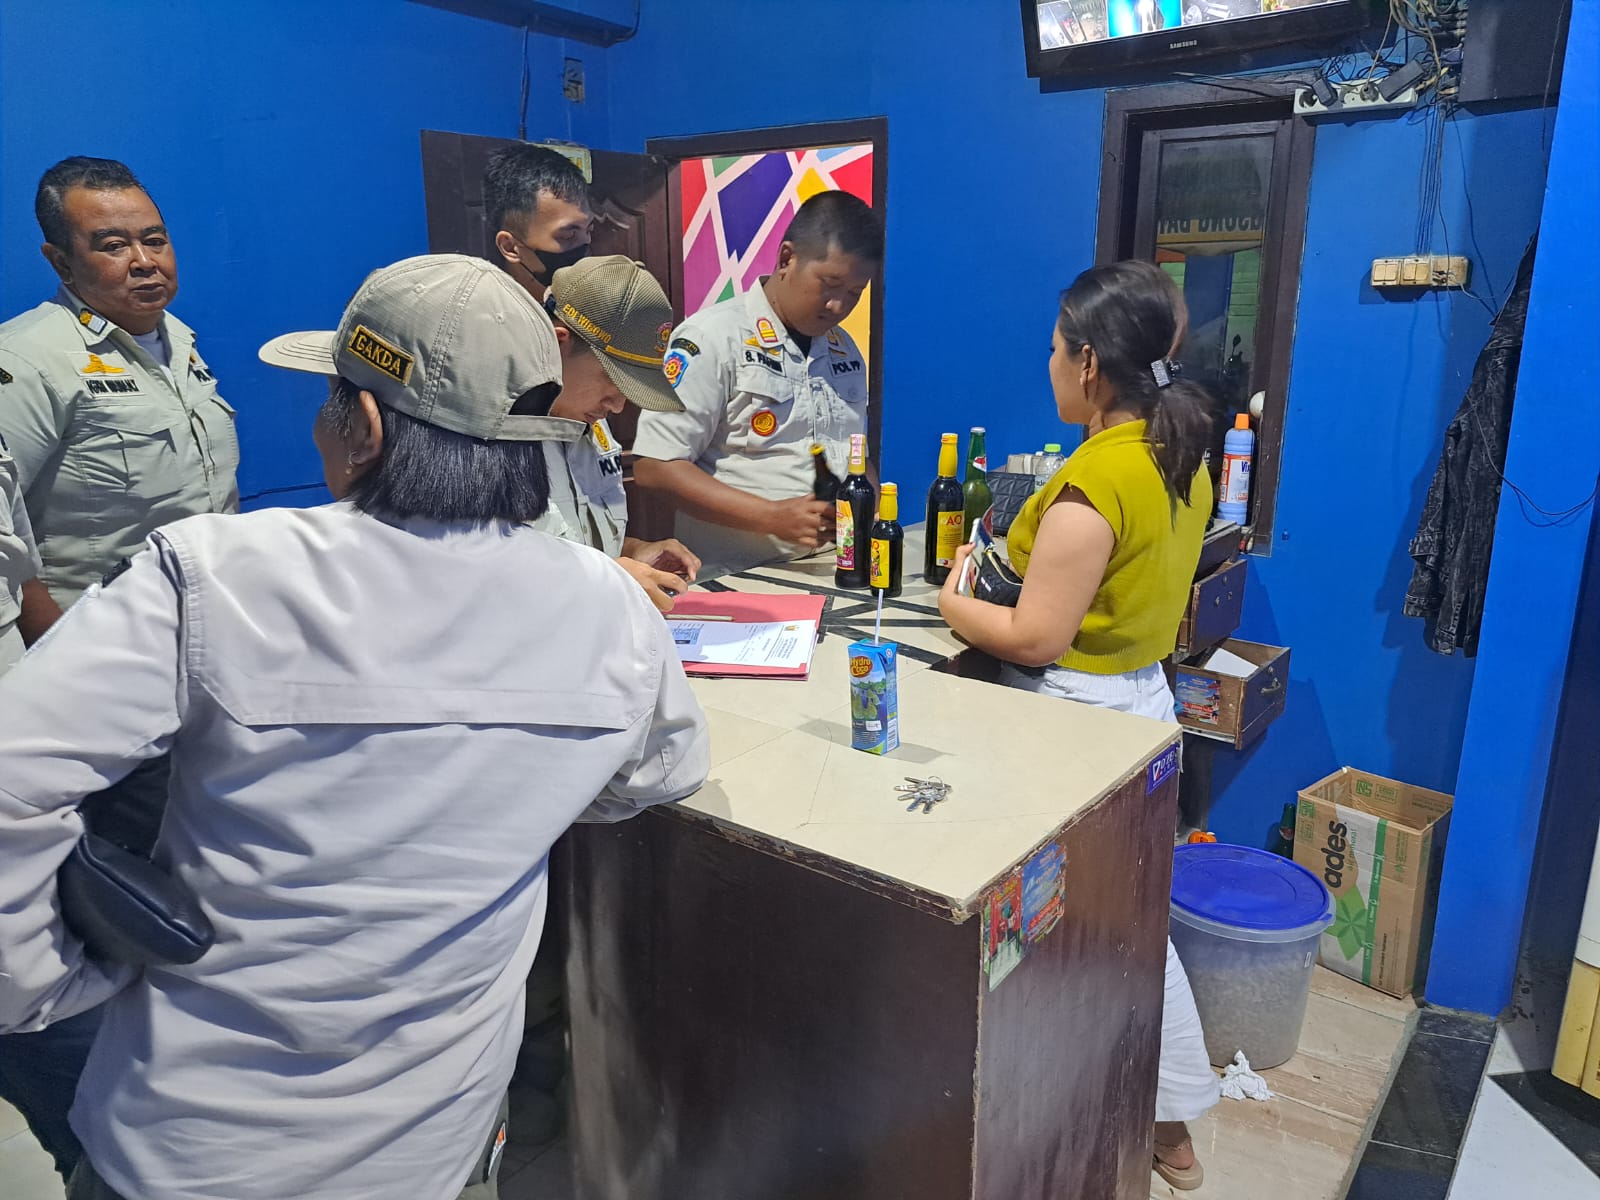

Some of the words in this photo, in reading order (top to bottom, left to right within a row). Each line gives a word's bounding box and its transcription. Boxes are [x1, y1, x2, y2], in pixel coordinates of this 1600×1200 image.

[1170, 40, 1197, 48] SAMSUNG
[563, 304, 579, 318] EDI
[356, 335, 401, 375] GAKDA
[832, 363, 852, 375] POL
[599, 458, 617, 477] POL
[850, 656, 871, 667] Hydro
[1321, 820, 1347, 888] ades
